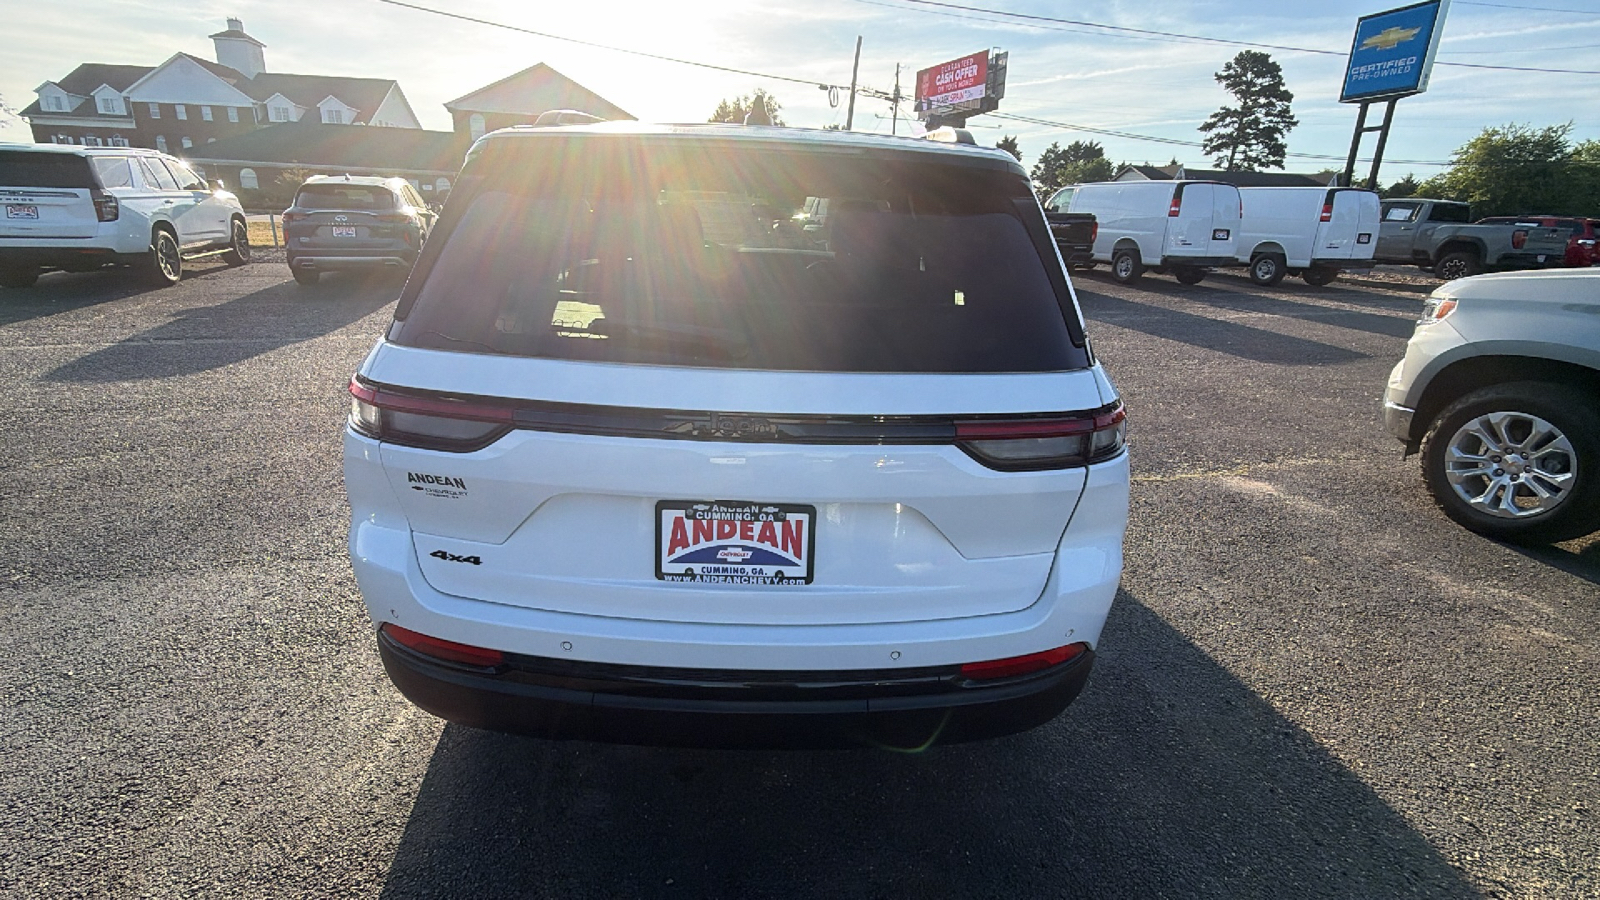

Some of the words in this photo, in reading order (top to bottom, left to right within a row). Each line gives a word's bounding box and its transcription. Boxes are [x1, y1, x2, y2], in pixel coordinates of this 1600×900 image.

[1351, 56, 1417, 74] CERTIFIED
[1352, 65, 1411, 81] PRE-OWNED
[936, 71, 954, 85] CASH
[955, 64, 978, 80] OFFER
[408, 471, 467, 490] ANDEAN
[696, 511, 754, 521] CUMMING,
[759, 514, 774, 522] GA
[712, 504, 758, 513] ANDEAN
[667, 516, 803, 560] ANDEAN
[429, 550, 483, 566] 4x4
[701, 566, 749, 576] CUMMING,
[752, 567, 768, 576] GA.
[664, 574, 806, 586] www.ANDEANCHEVY.com
